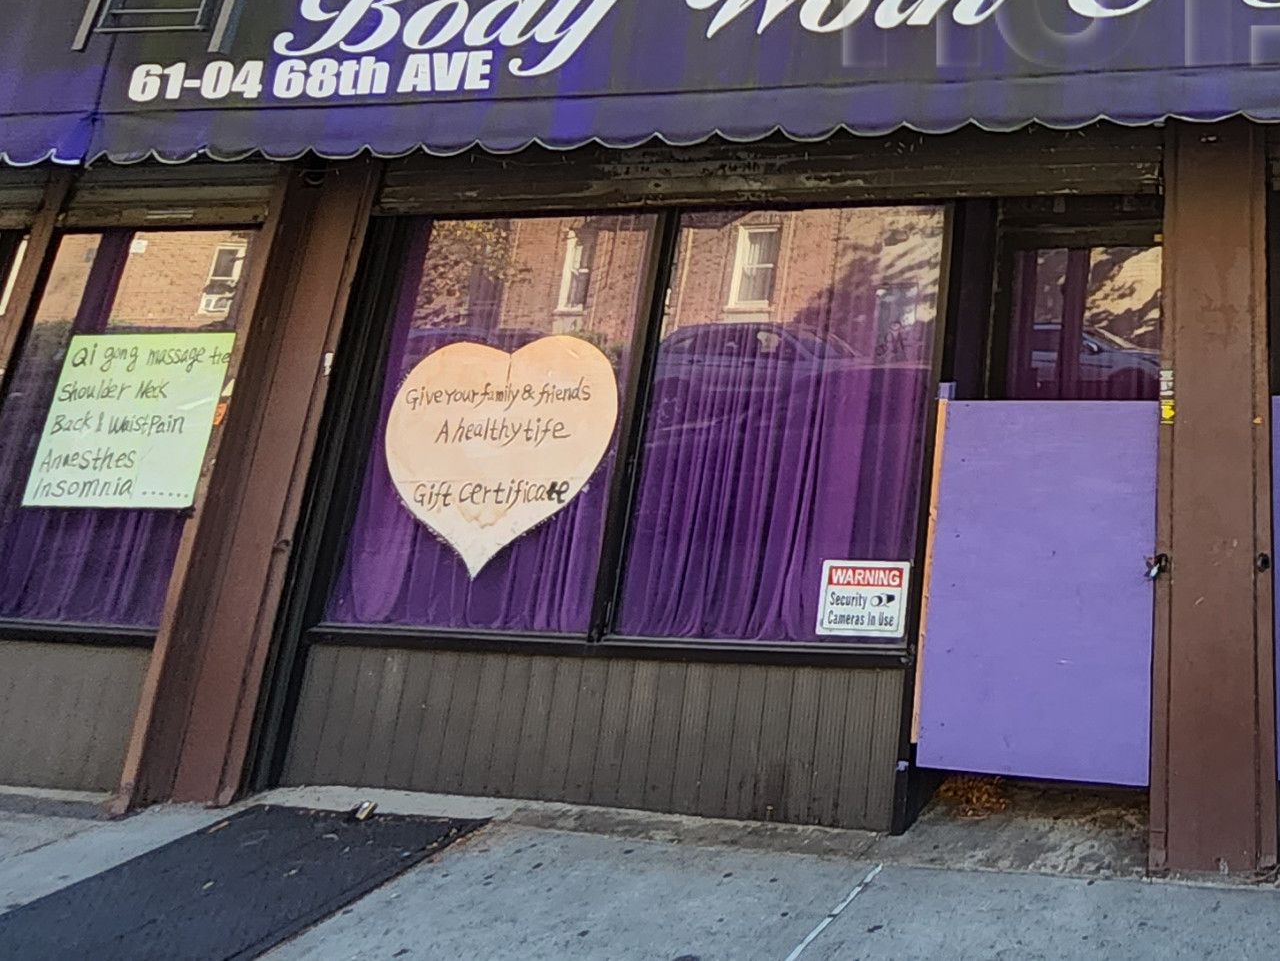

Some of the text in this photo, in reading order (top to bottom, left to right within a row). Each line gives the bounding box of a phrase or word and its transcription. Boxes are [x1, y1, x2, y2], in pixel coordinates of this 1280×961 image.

[128, 50, 492, 102] 61-04 68th AVE
[522, 384, 534, 399] &
[533, 377, 592, 407] friends
[434, 418, 449, 444] A
[413, 481, 453, 511] Gift
[831, 568, 900, 585] WARNING
[829, 591, 867, 610] Security
[828, 610, 894, 627] Cameras In Use
